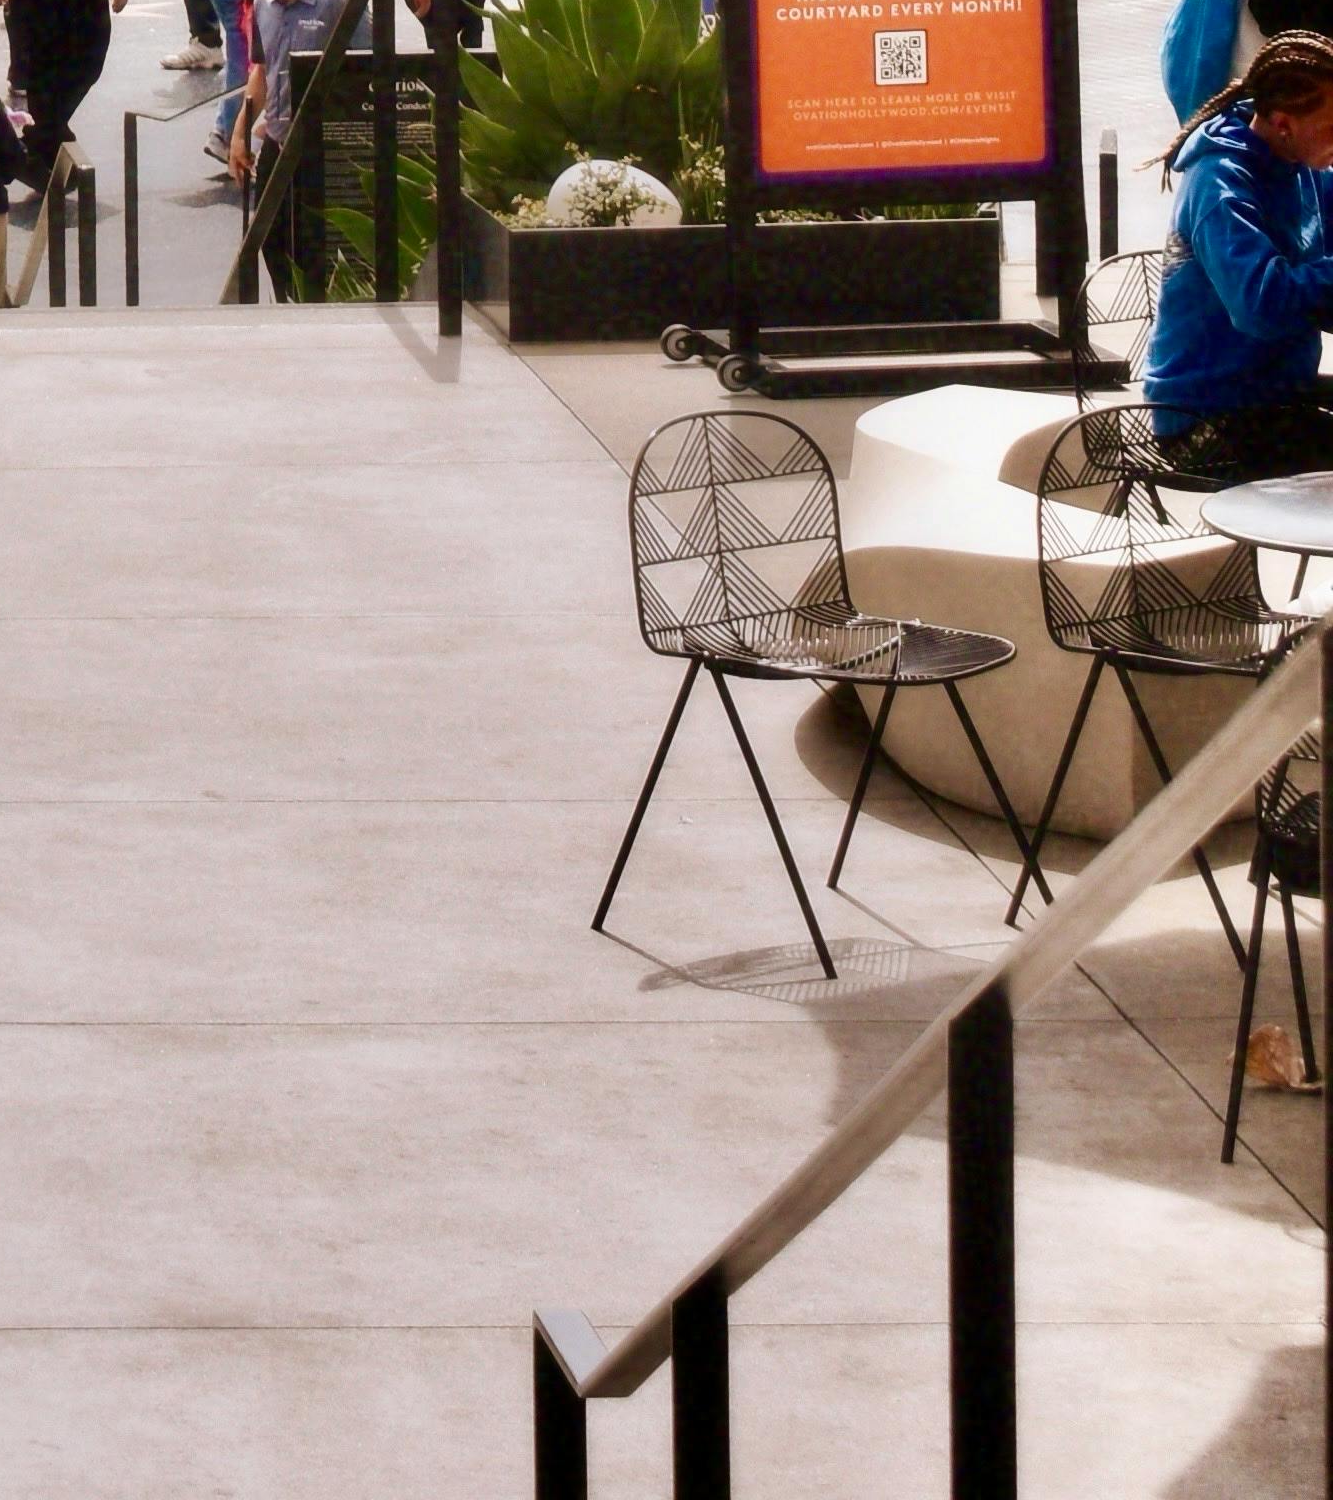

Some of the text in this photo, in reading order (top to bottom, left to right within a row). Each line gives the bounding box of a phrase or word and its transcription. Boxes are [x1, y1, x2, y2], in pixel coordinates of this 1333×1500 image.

[776, 4, 884, 21] COURTYARD
[890, 1, 944, 16] EVERY
[787, 90, 1017, 109] SCAN HERE TO LEARN MORE OR VISIT
[793, 103, 1012, 122] OVATIONHOLLYWOOD.COM/EVENTS
